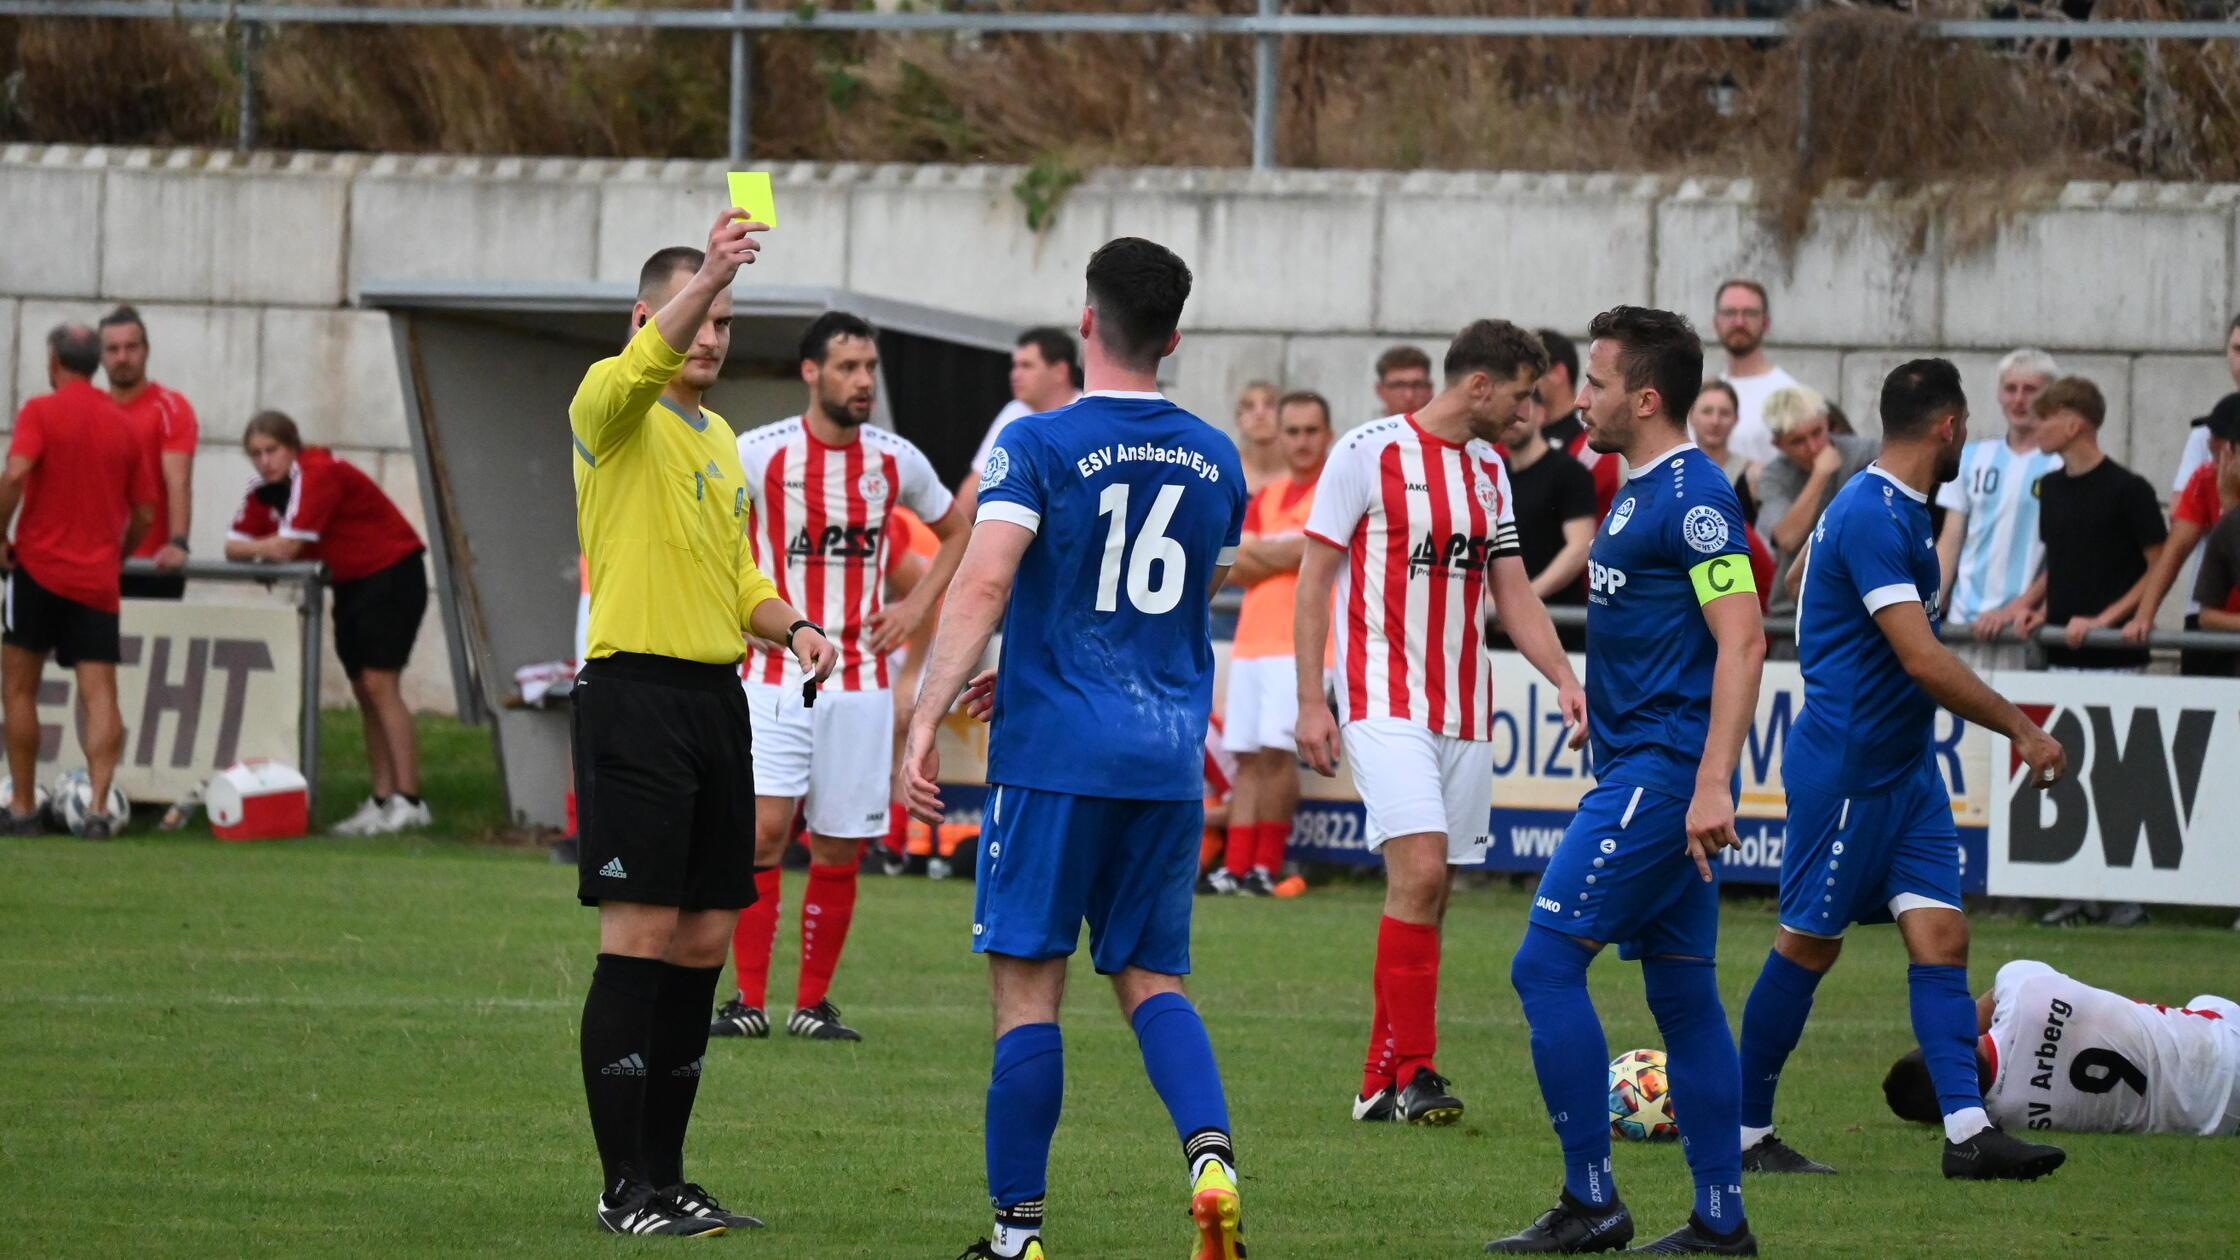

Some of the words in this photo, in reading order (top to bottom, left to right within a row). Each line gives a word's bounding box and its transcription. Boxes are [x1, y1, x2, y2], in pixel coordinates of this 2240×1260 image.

[1077, 446, 1112, 479] ESV
[1117, 442, 1220, 483] Ansbach/Eyb
[1404, 482, 1430, 493] JAKO
[1974, 466, 1999, 495] 10
[1095, 482, 1187, 615] 16
[1707, 558, 1735, 593] C
[2009, 703, 2216, 871] BW
[599, 869, 627, 879] adidas
[1536, 896, 1561, 913] JAKO
[2029, 998, 2073, 1091] Arberg
[2069, 1047, 2148, 1098] 9
[2027, 1102, 2052, 1131] SV
